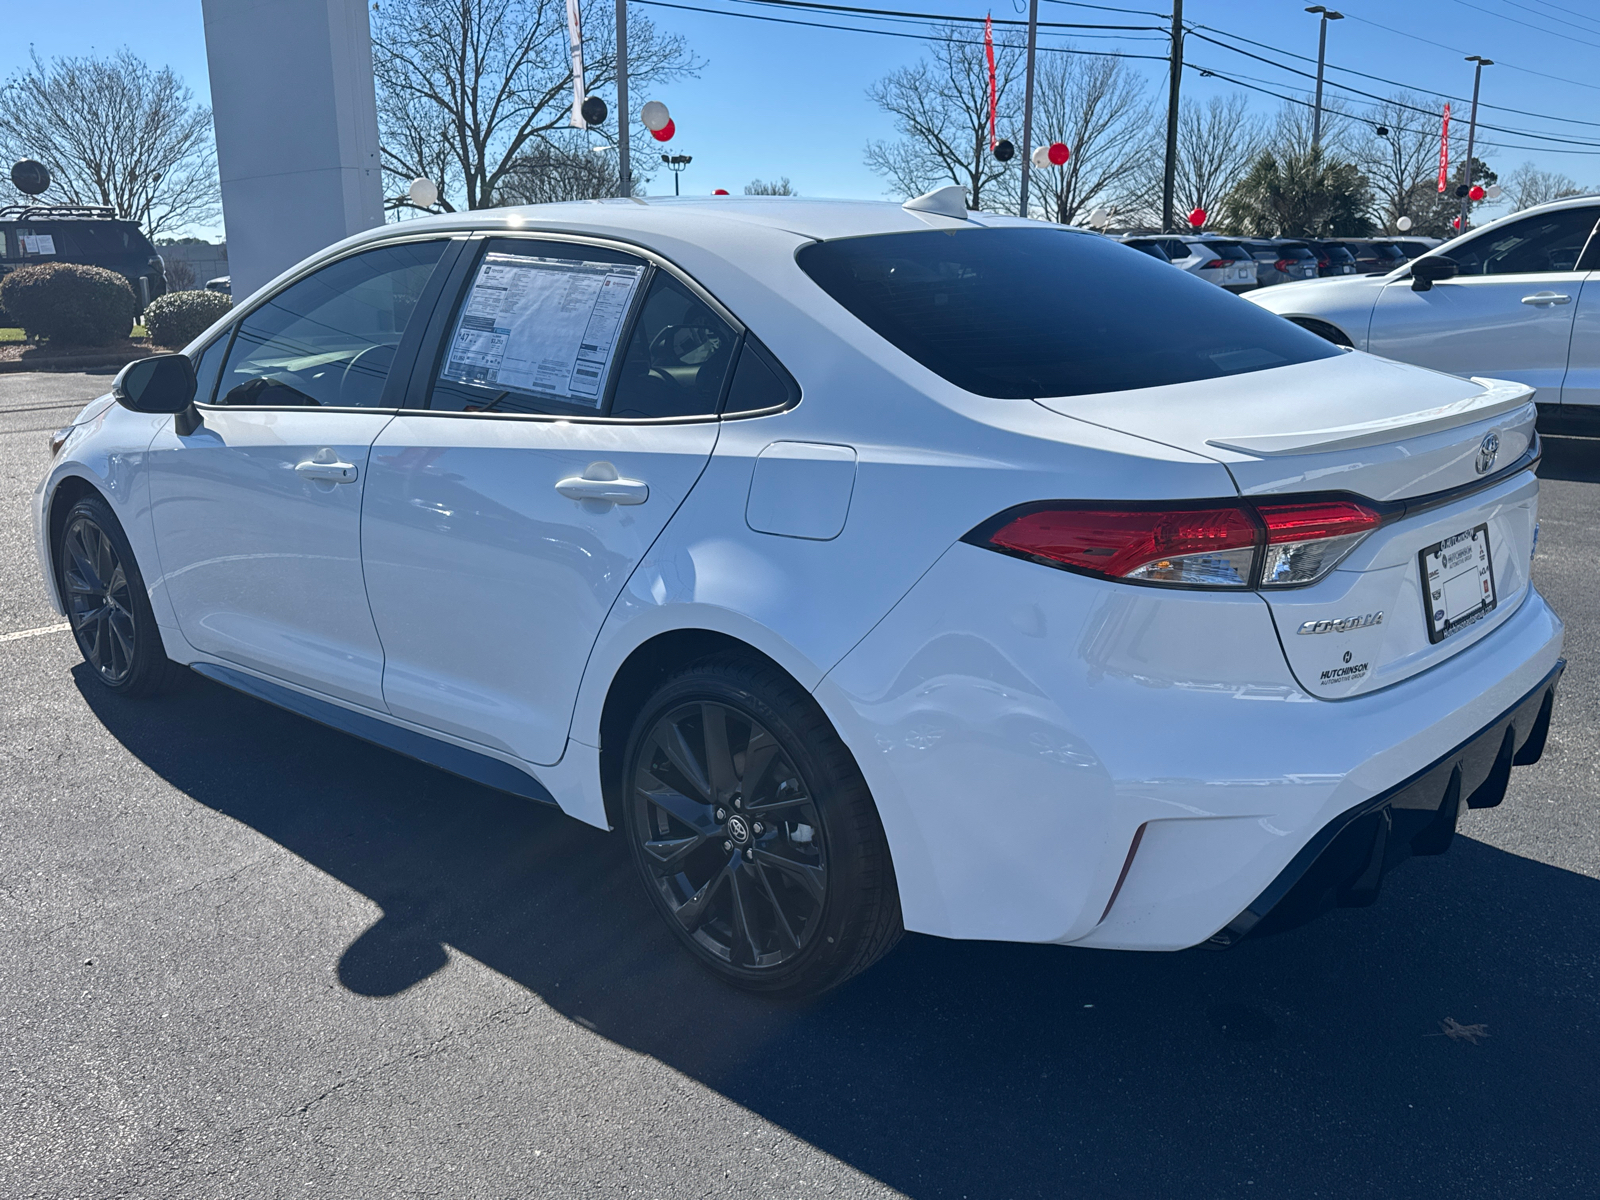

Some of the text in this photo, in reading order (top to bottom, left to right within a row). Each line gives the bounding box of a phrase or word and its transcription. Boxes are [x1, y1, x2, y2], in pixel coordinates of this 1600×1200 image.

[1297, 611, 1384, 635] COROLLA
[1320, 662, 1369, 680] HUTCHINSON
[1320, 671, 1366, 686] AUTOMOTIVE GROUP
